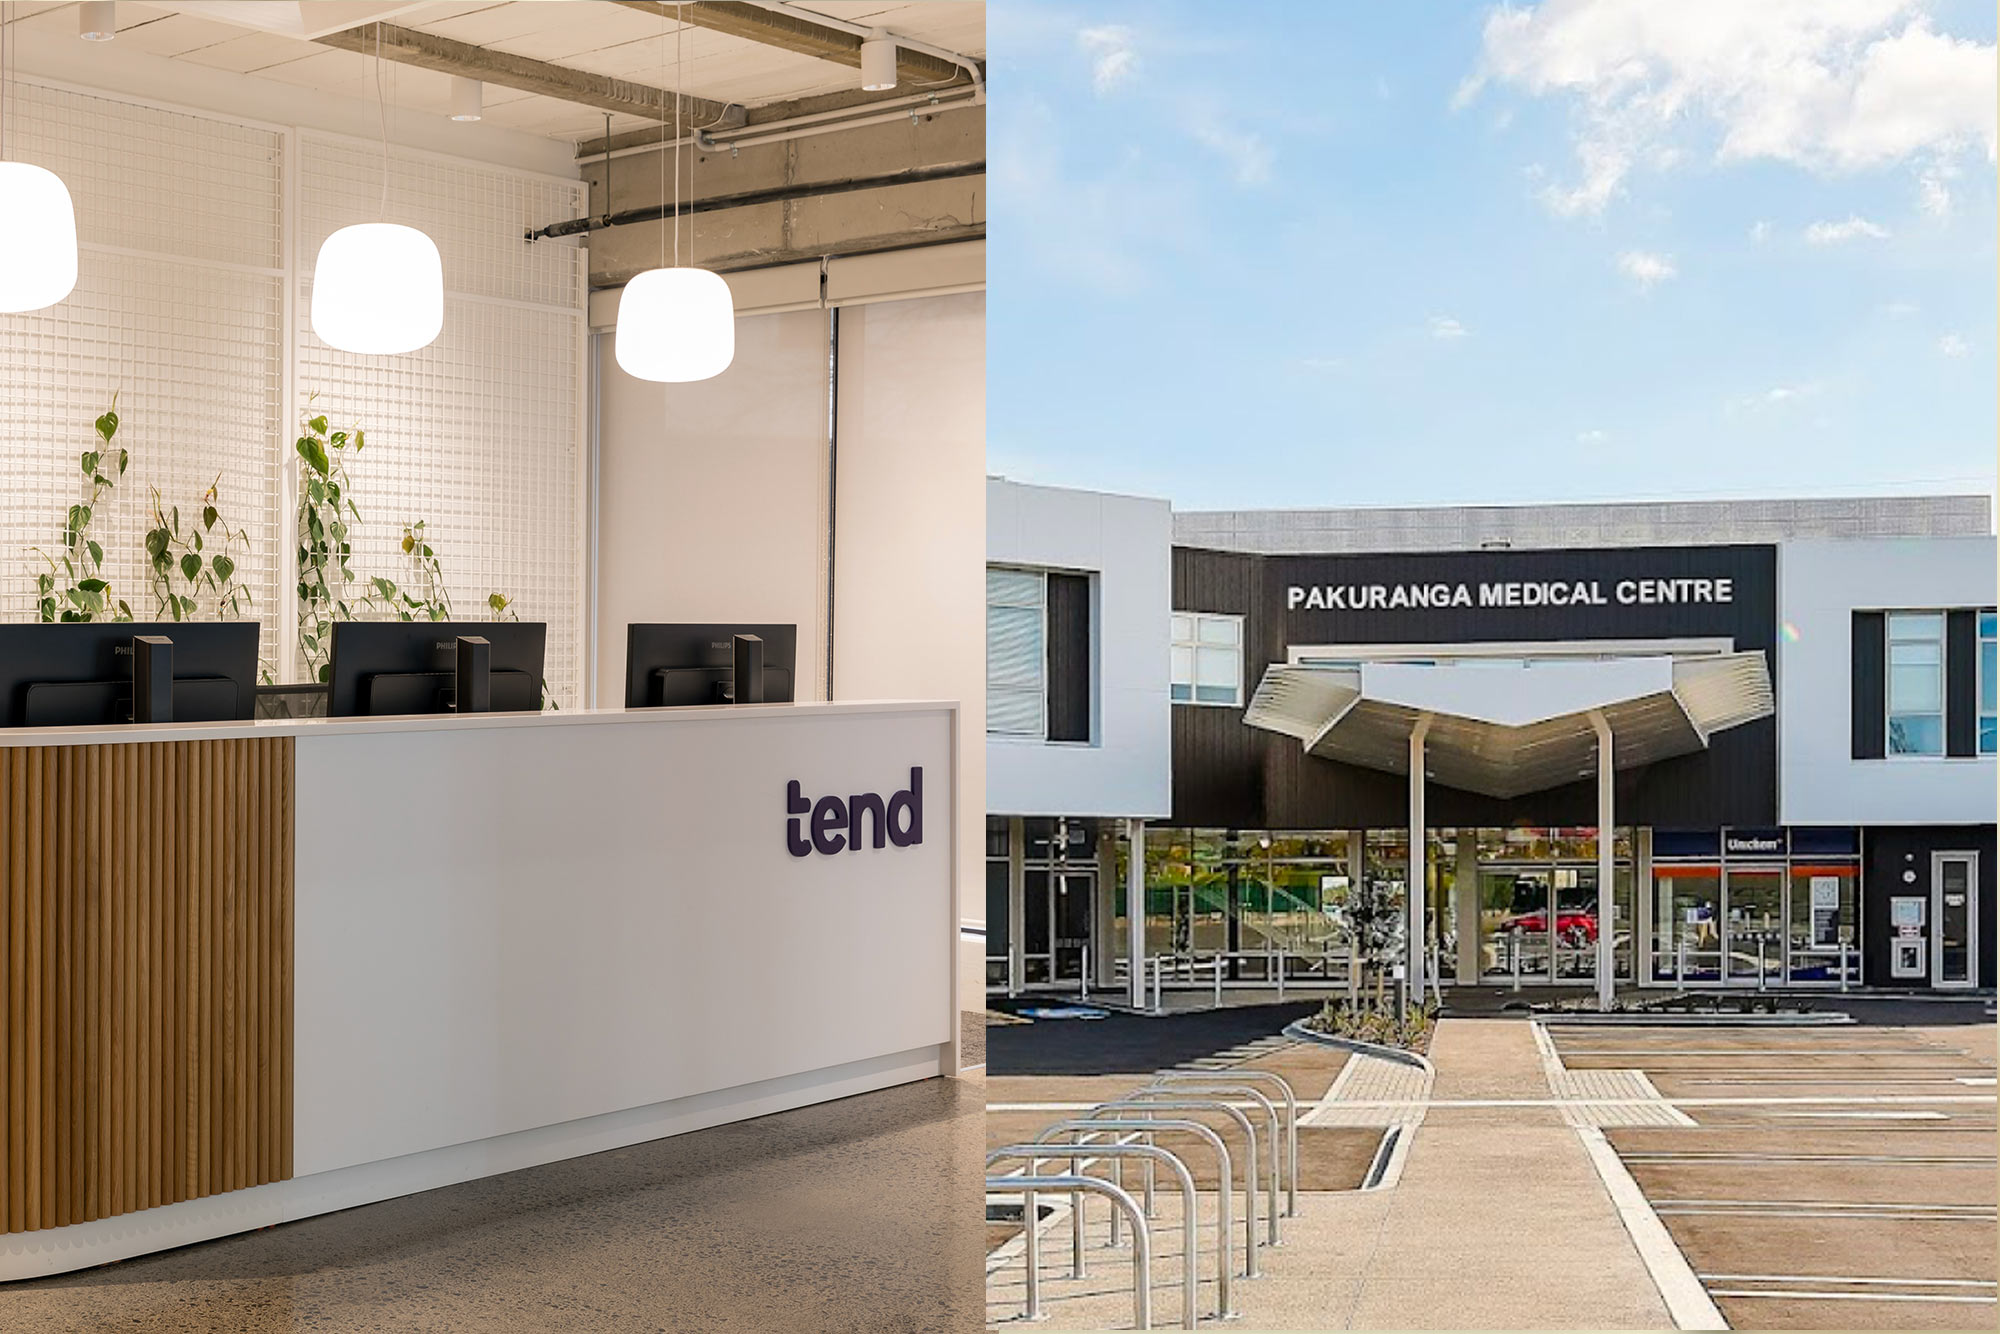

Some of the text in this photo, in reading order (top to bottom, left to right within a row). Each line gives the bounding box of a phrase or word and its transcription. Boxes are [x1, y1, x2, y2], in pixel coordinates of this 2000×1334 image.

[1287, 578, 1733, 610] PAKURANGA MEDICAL CENTRE
[114, 646, 134, 655] PHIL
[436, 641, 457, 650] PHILIP
[787, 766, 923, 858] tend
